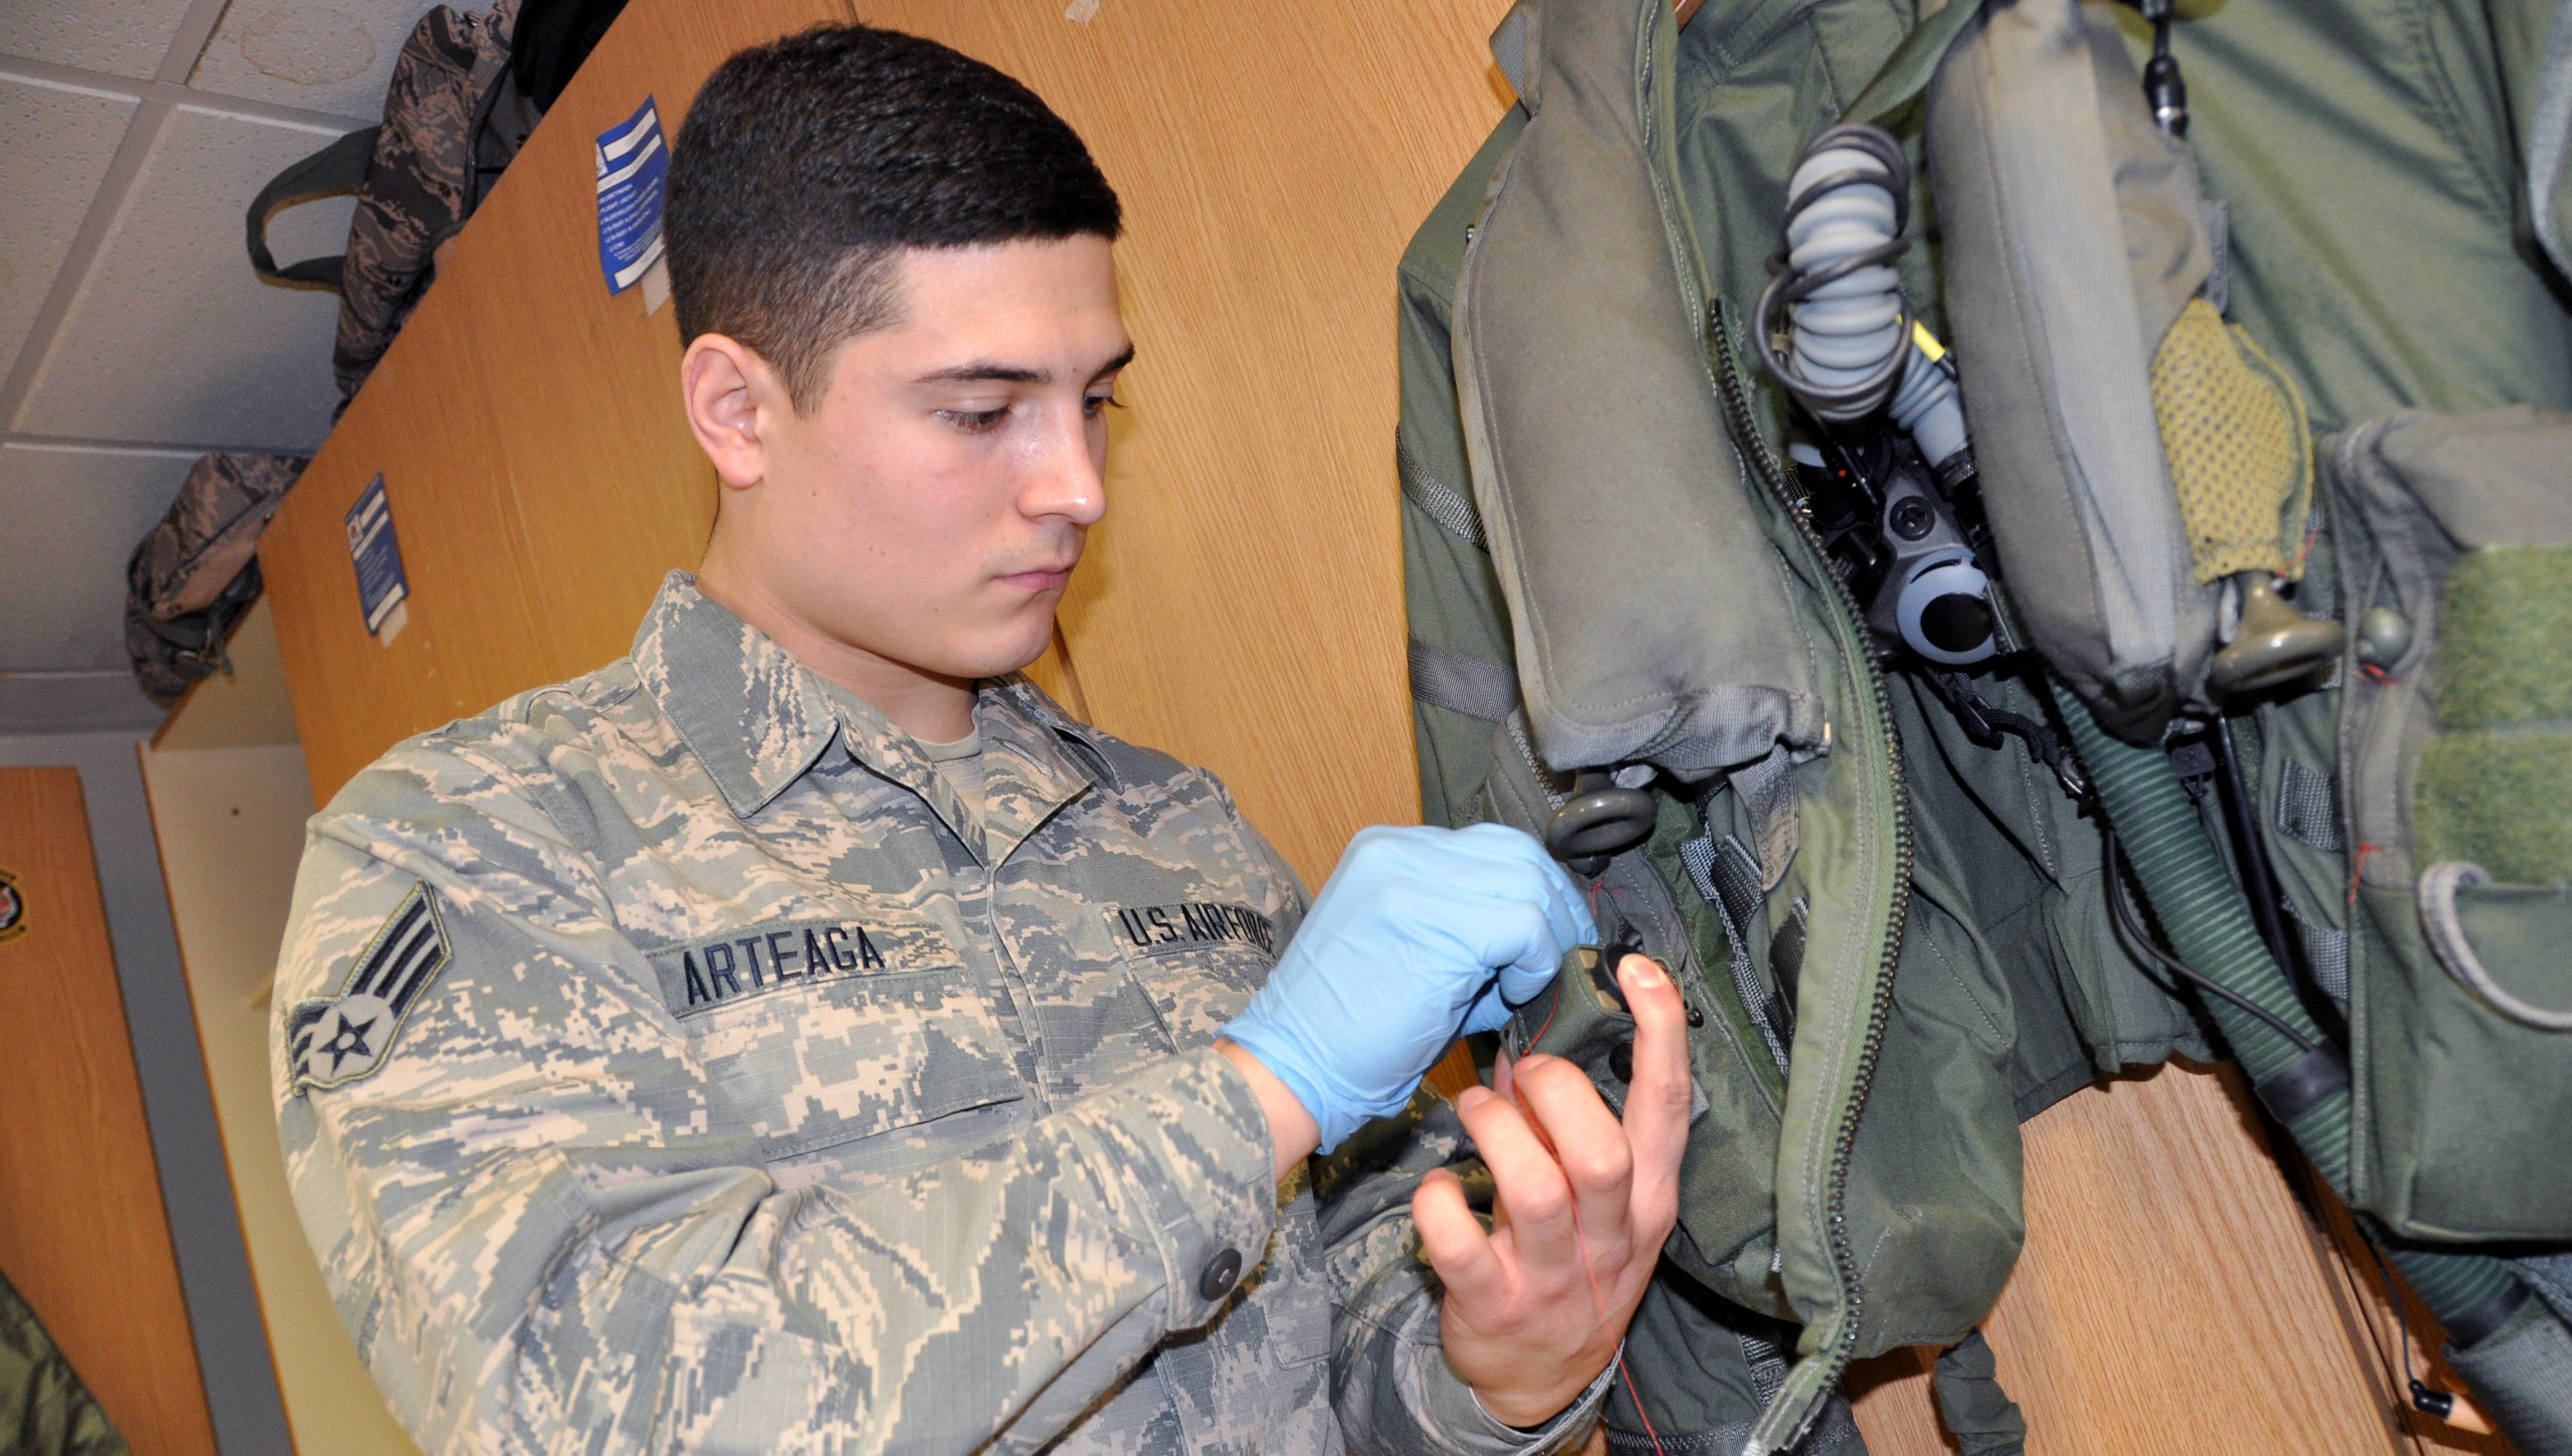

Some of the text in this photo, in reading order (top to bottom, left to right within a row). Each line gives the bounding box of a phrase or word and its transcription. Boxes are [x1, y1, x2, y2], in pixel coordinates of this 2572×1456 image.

[1118, 907, 1186, 946] U.S.
[1180, 903, 1233, 941] AIR
[683, 926, 885, 1006] ARTEAGA
